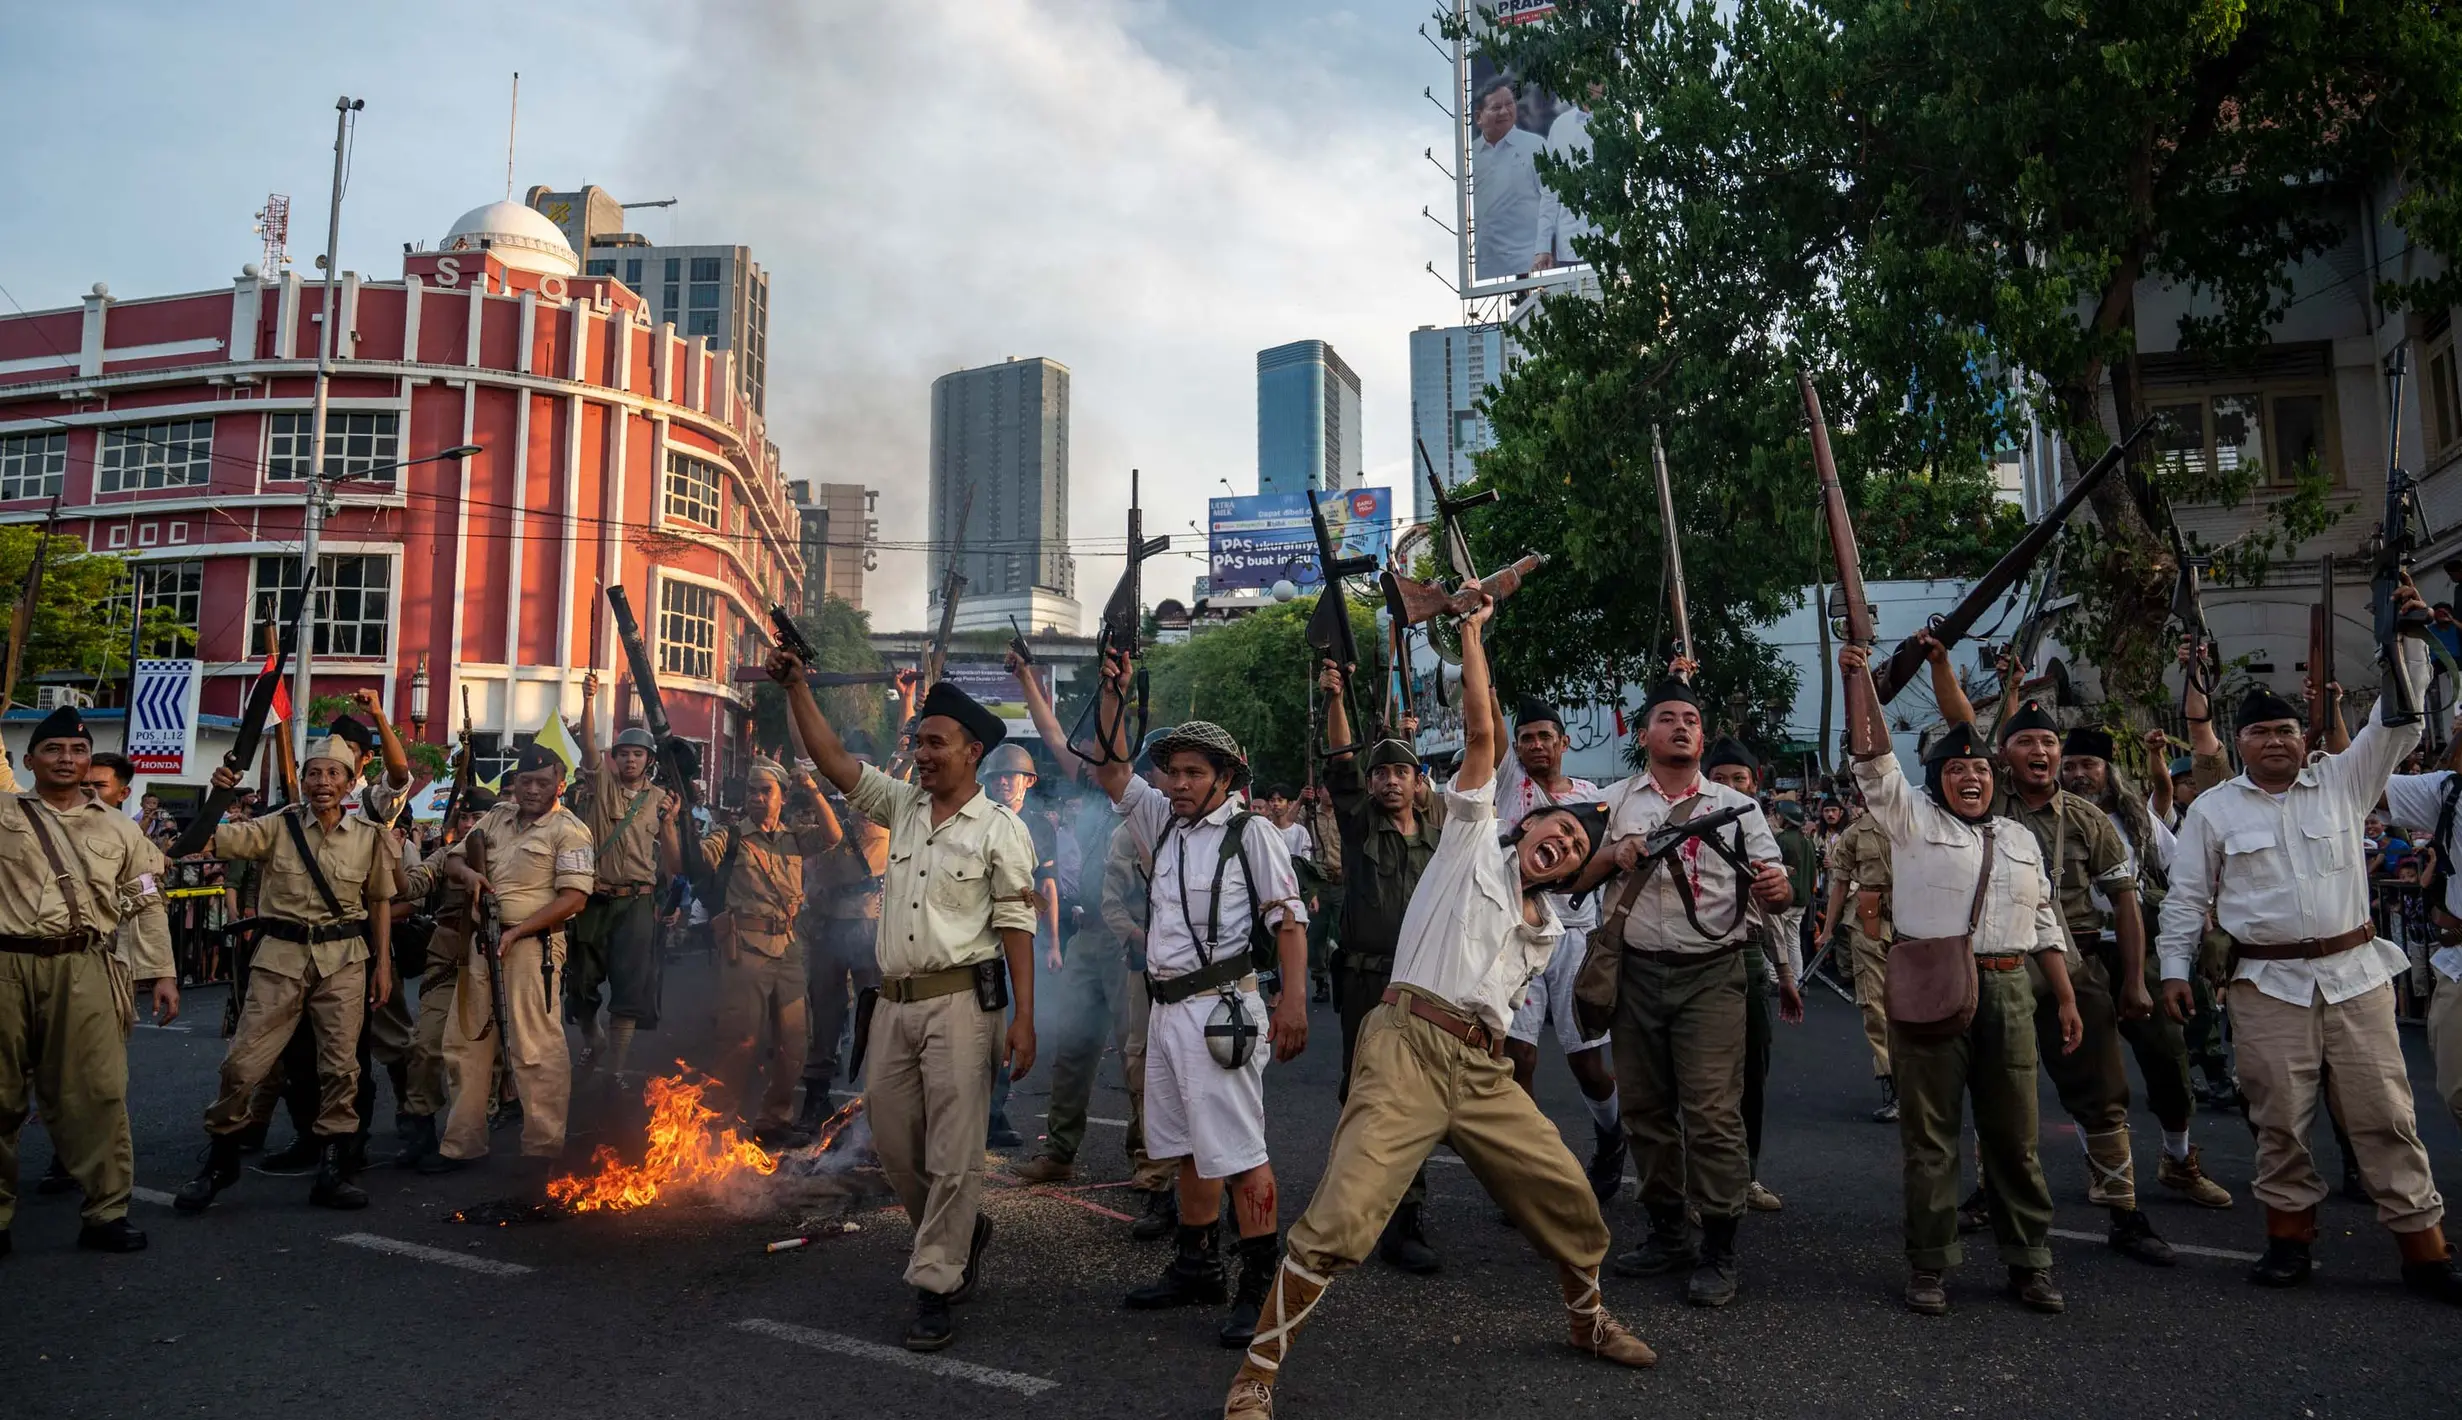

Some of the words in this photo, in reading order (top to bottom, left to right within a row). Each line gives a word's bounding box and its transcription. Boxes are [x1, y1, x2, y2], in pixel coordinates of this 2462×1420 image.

[435, 257, 652, 326] SIOLA
[1258, 510, 1281, 518] Dapat
[864, 490, 879, 572] TEC
[1221, 537, 1252, 554] PAS
[1255, 541, 1319, 553] ukurannya
[1212, 554, 1244, 569] PAS
[1247, 554, 1275, 566] buat
[163, 731, 183, 741] 1.12
[141, 761, 180, 770] HONDA
